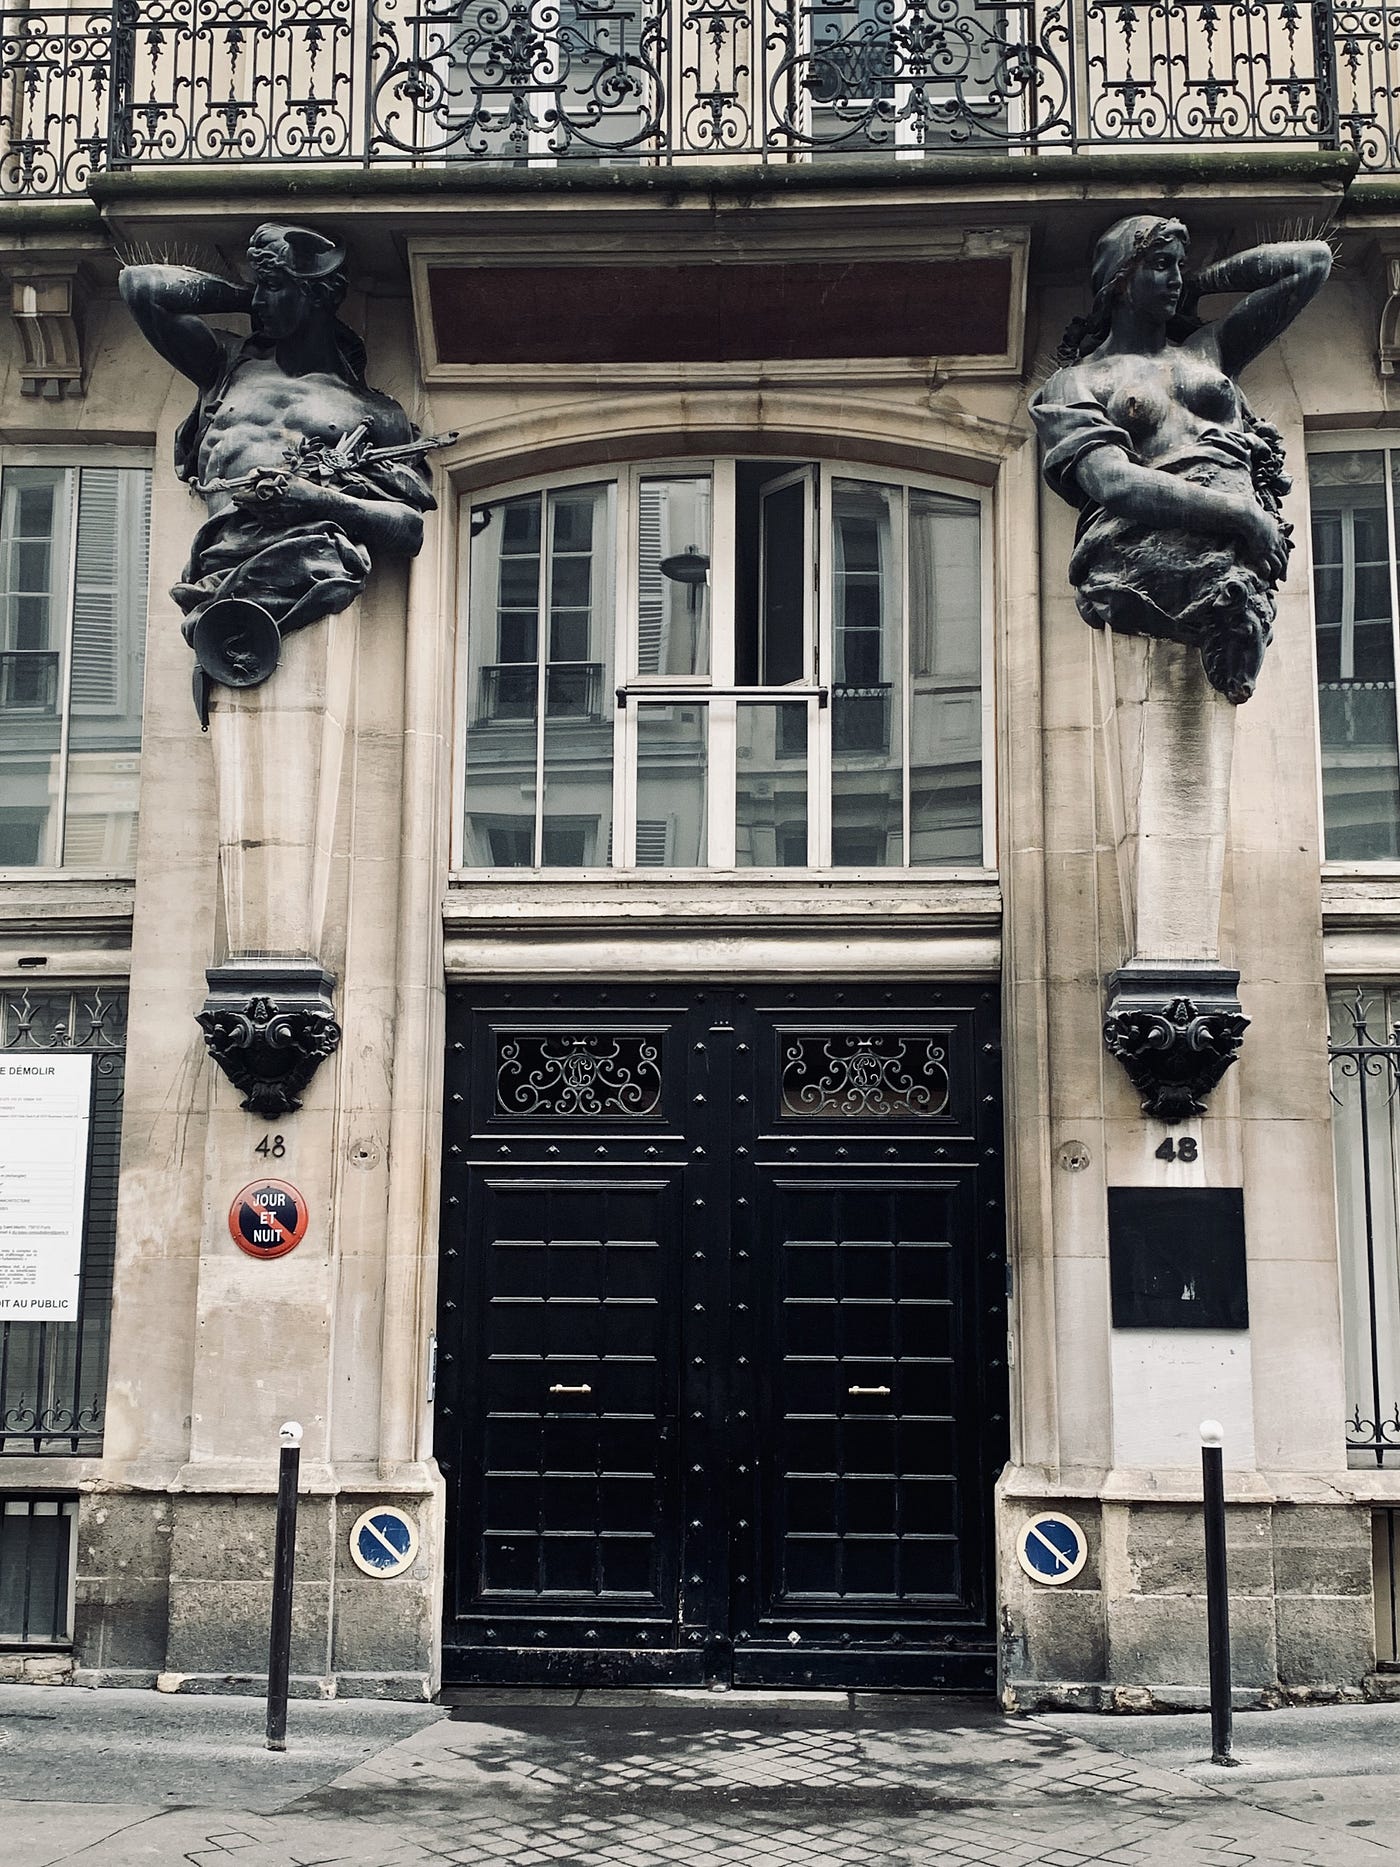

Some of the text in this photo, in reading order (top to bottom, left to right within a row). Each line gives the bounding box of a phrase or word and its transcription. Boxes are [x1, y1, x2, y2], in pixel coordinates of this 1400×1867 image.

[9, 1065, 55, 1075] DÉMOLIR
[255, 1134, 286, 1158] 48
[1155, 1137, 1198, 1163] 48
[253, 1194, 286, 1207] JOUR
[260, 1212, 277, 1225] ET
[253, 1230, 282, 1243] NUIT
[0, 1299, 69, 1308] IT AU PUBLIC
